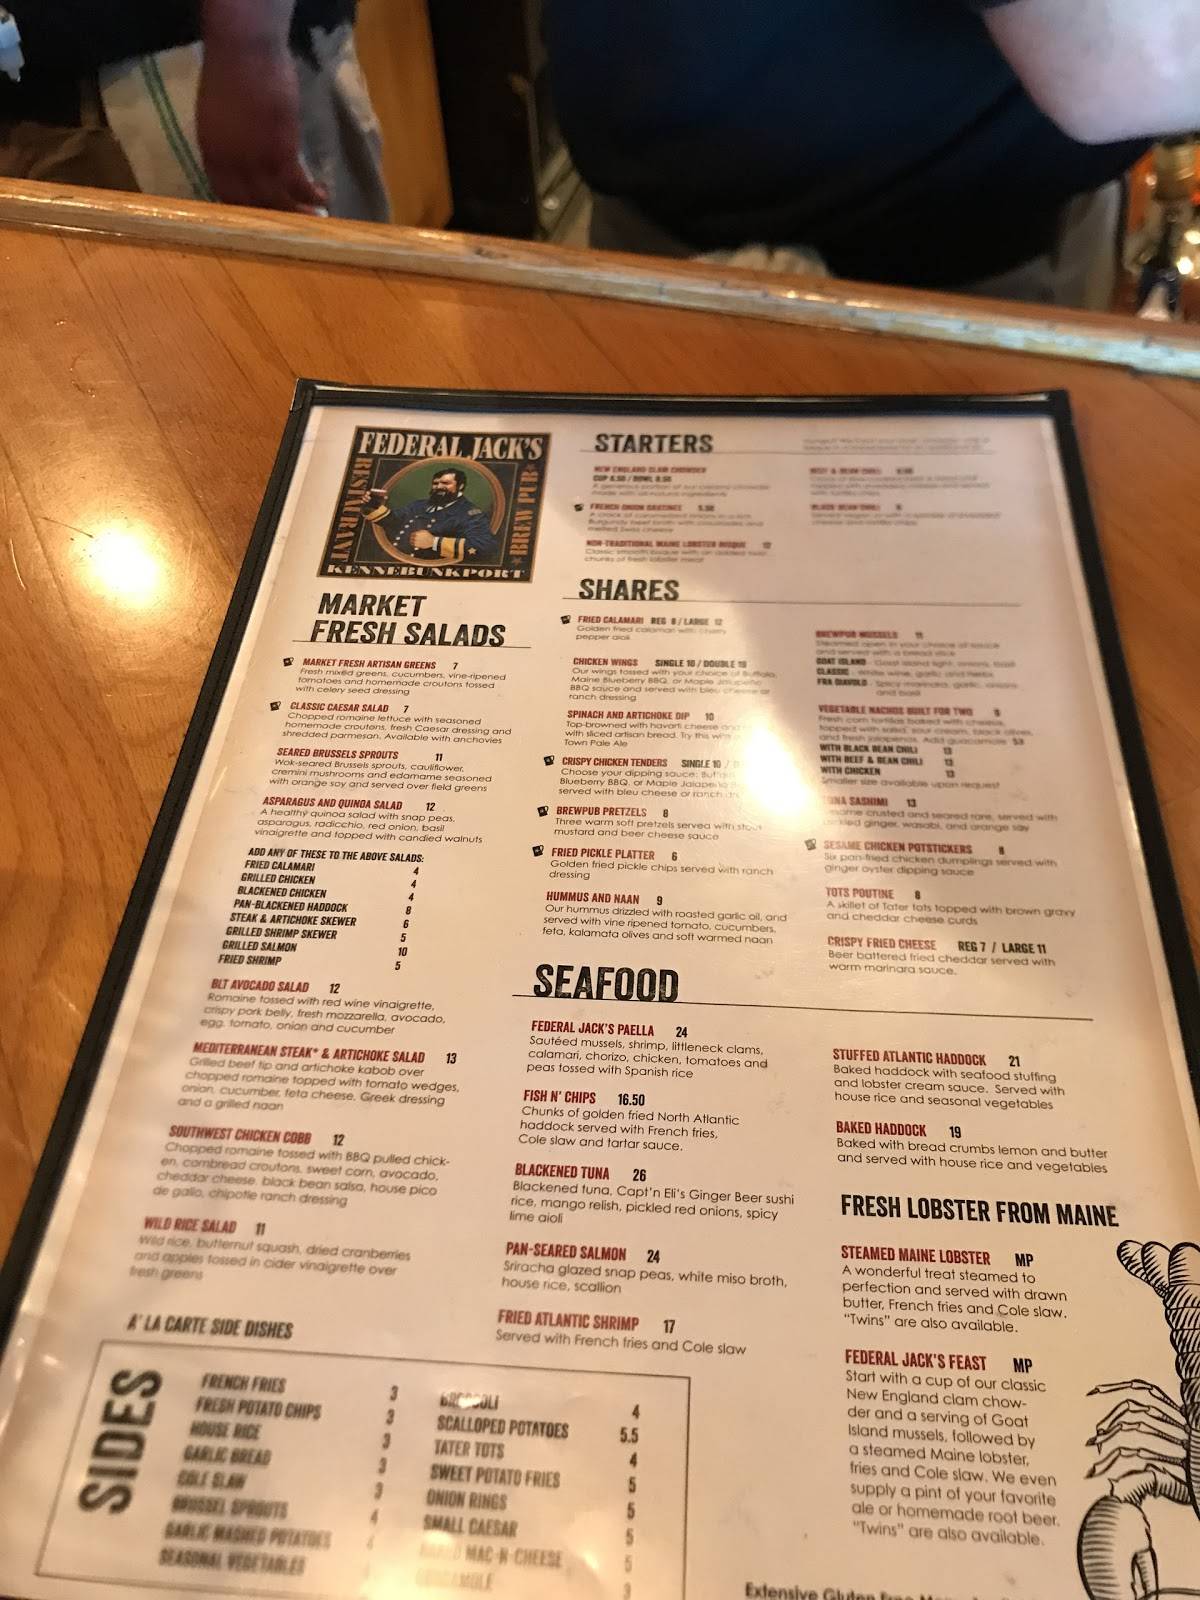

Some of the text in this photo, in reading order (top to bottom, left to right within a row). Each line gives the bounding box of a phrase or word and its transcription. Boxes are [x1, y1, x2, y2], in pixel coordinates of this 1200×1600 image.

[358, 431, 544, 460] FEDERAL JACK'S
[594, 433, 713, 454] STARTERS
[509, 470, 539, 556] BREW PUB
[327, 564, 526, 579] KENNEBUNKPORT
[577, 577, 679, 601] SHARES
[317, 592, 427, 617] MARKET
[309, 619, 506, 648] FRESH SALADS
[302, 657, 459, 670] MARKET FRESH ARTISAN GREENS 7
[289, 701, 409, 713] CLASSIC CAESAR SALAD 7
[566, 709, 714, 721] SPINACH AND ARTICHOKE DIP 10
[276, 747, 443, 761] SEARED BRUSSELS SPROUTS 11
[262, 796, 436, 812] ASPARAGUS AND QUINOA SALAD 12
[556, 805, 669, 818] BREWPUB PRETZELS 8
[270, 808, 309, 818] healthy
[310, 810, 346, 818] quinoa
[347, 811, 376, 819] salad
[378, 812, 399, 820] with
[400, 814, 426, 823] snap
[427, 815, 455, 823] peas,
[551, 847, 678, 862] FRIED PICKLE PLATTER 6
[233, 898, 412, 915] PAN-BLACKENED HADDOCK 8
[546, 890, 663, 906] HUMMUS AND NAAN 9
[827, 935, 1047, 954] CRISPY FRIED CHEESE REG 7 / LARGE 11
[210, 978, 341, 994] BLT AVOCADO SALAD 12
[532, 963, 679, 1004] SEAFOOD
[531, 1020, 688, 1038] FEDERAL JACK'S PAELLA 24
[529, 1035, 763, 1055] Sautéed mussels, shrimp, littleneck clams,
[832, 1048, 1020, 1067] STUFFED ATLANTIC HADDOCK 21
[523, 1089, 645, 1106] FISH N' CHIPS 16.50
[521, 1105, 740, 1125] Chunks of golden fried North Atlantic
[836, 1120, 962, 1139] BAKED HADDOCK 19
[836, 1137, 1107, 1159] Baked with bread crumbs lemon and butter
[514, 1162, 647, 1182] BLACKENED TUNA 26
[512, 1180, 794, 1205] Blackened tuna, Capt'n Eli's Ginger Beer sushi
[840, 1193, 1119, 1227] FRESH LOBSTER FROM MAINE
[505, 1241, 660, 1264] PAN-SEARED SALMON 24
[841, 1244, 1034, 1267] STEAMED MAINE LOBSTER MP
[842, 1264, 1036, 1284] A wonderful treat steamed to
[126, 1313, 294, 1340] A' LA CARTE SIDE DISHES
[497, 1308, 676, 1334] FRIED ATLANTIC SHRIMP 17
[845, 1348, 1033, 1374] FEDERAL JACK'S FEAST MP
[436, 1414, 639, 1444] SCALLOPED POTATOES 5.5
[78, 1370, 163, 1514] SIDES
[429, 1463, 637, 1494] SWEET POTATO FRIES 5
